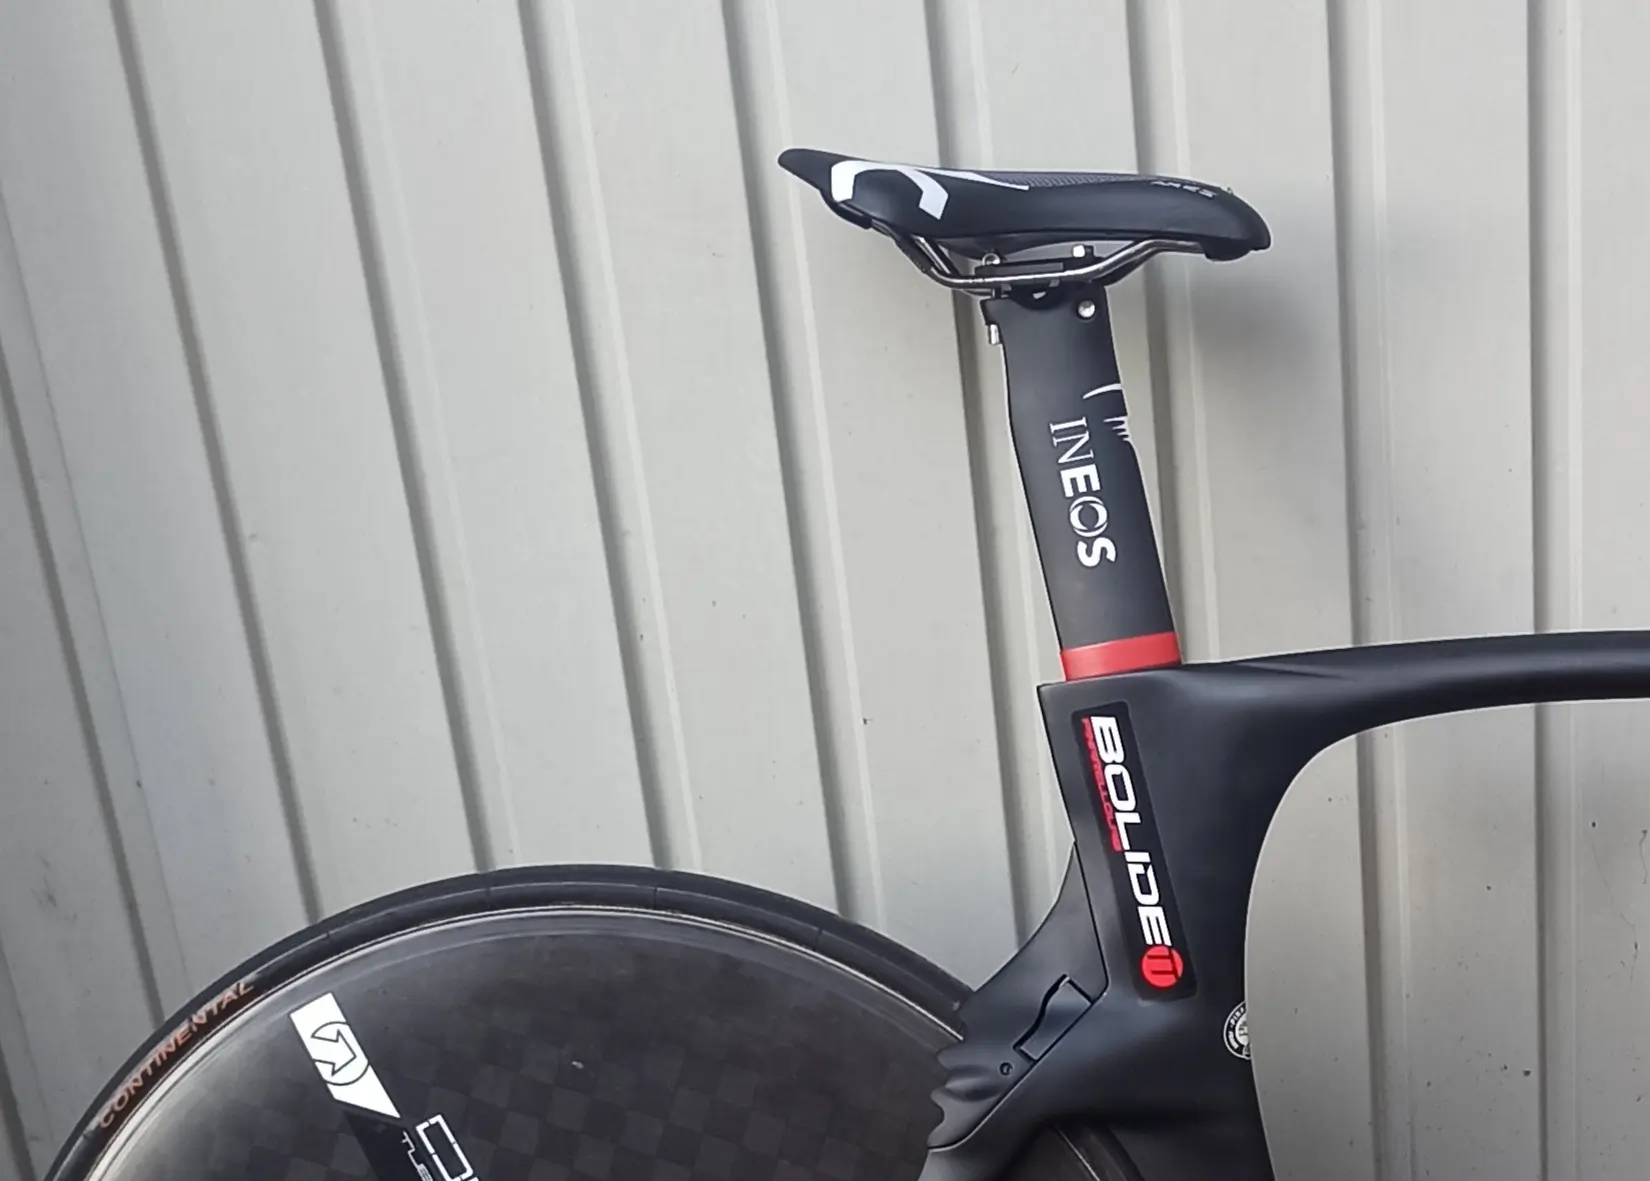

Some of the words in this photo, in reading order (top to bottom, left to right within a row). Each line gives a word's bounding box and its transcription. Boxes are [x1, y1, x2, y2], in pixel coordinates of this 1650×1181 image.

[1049, 416, 1117, 568] INEOS
[1090, 715, 1172, 946] BOLIDE
[99, 979, 254, 1129] CONTINENTAL
